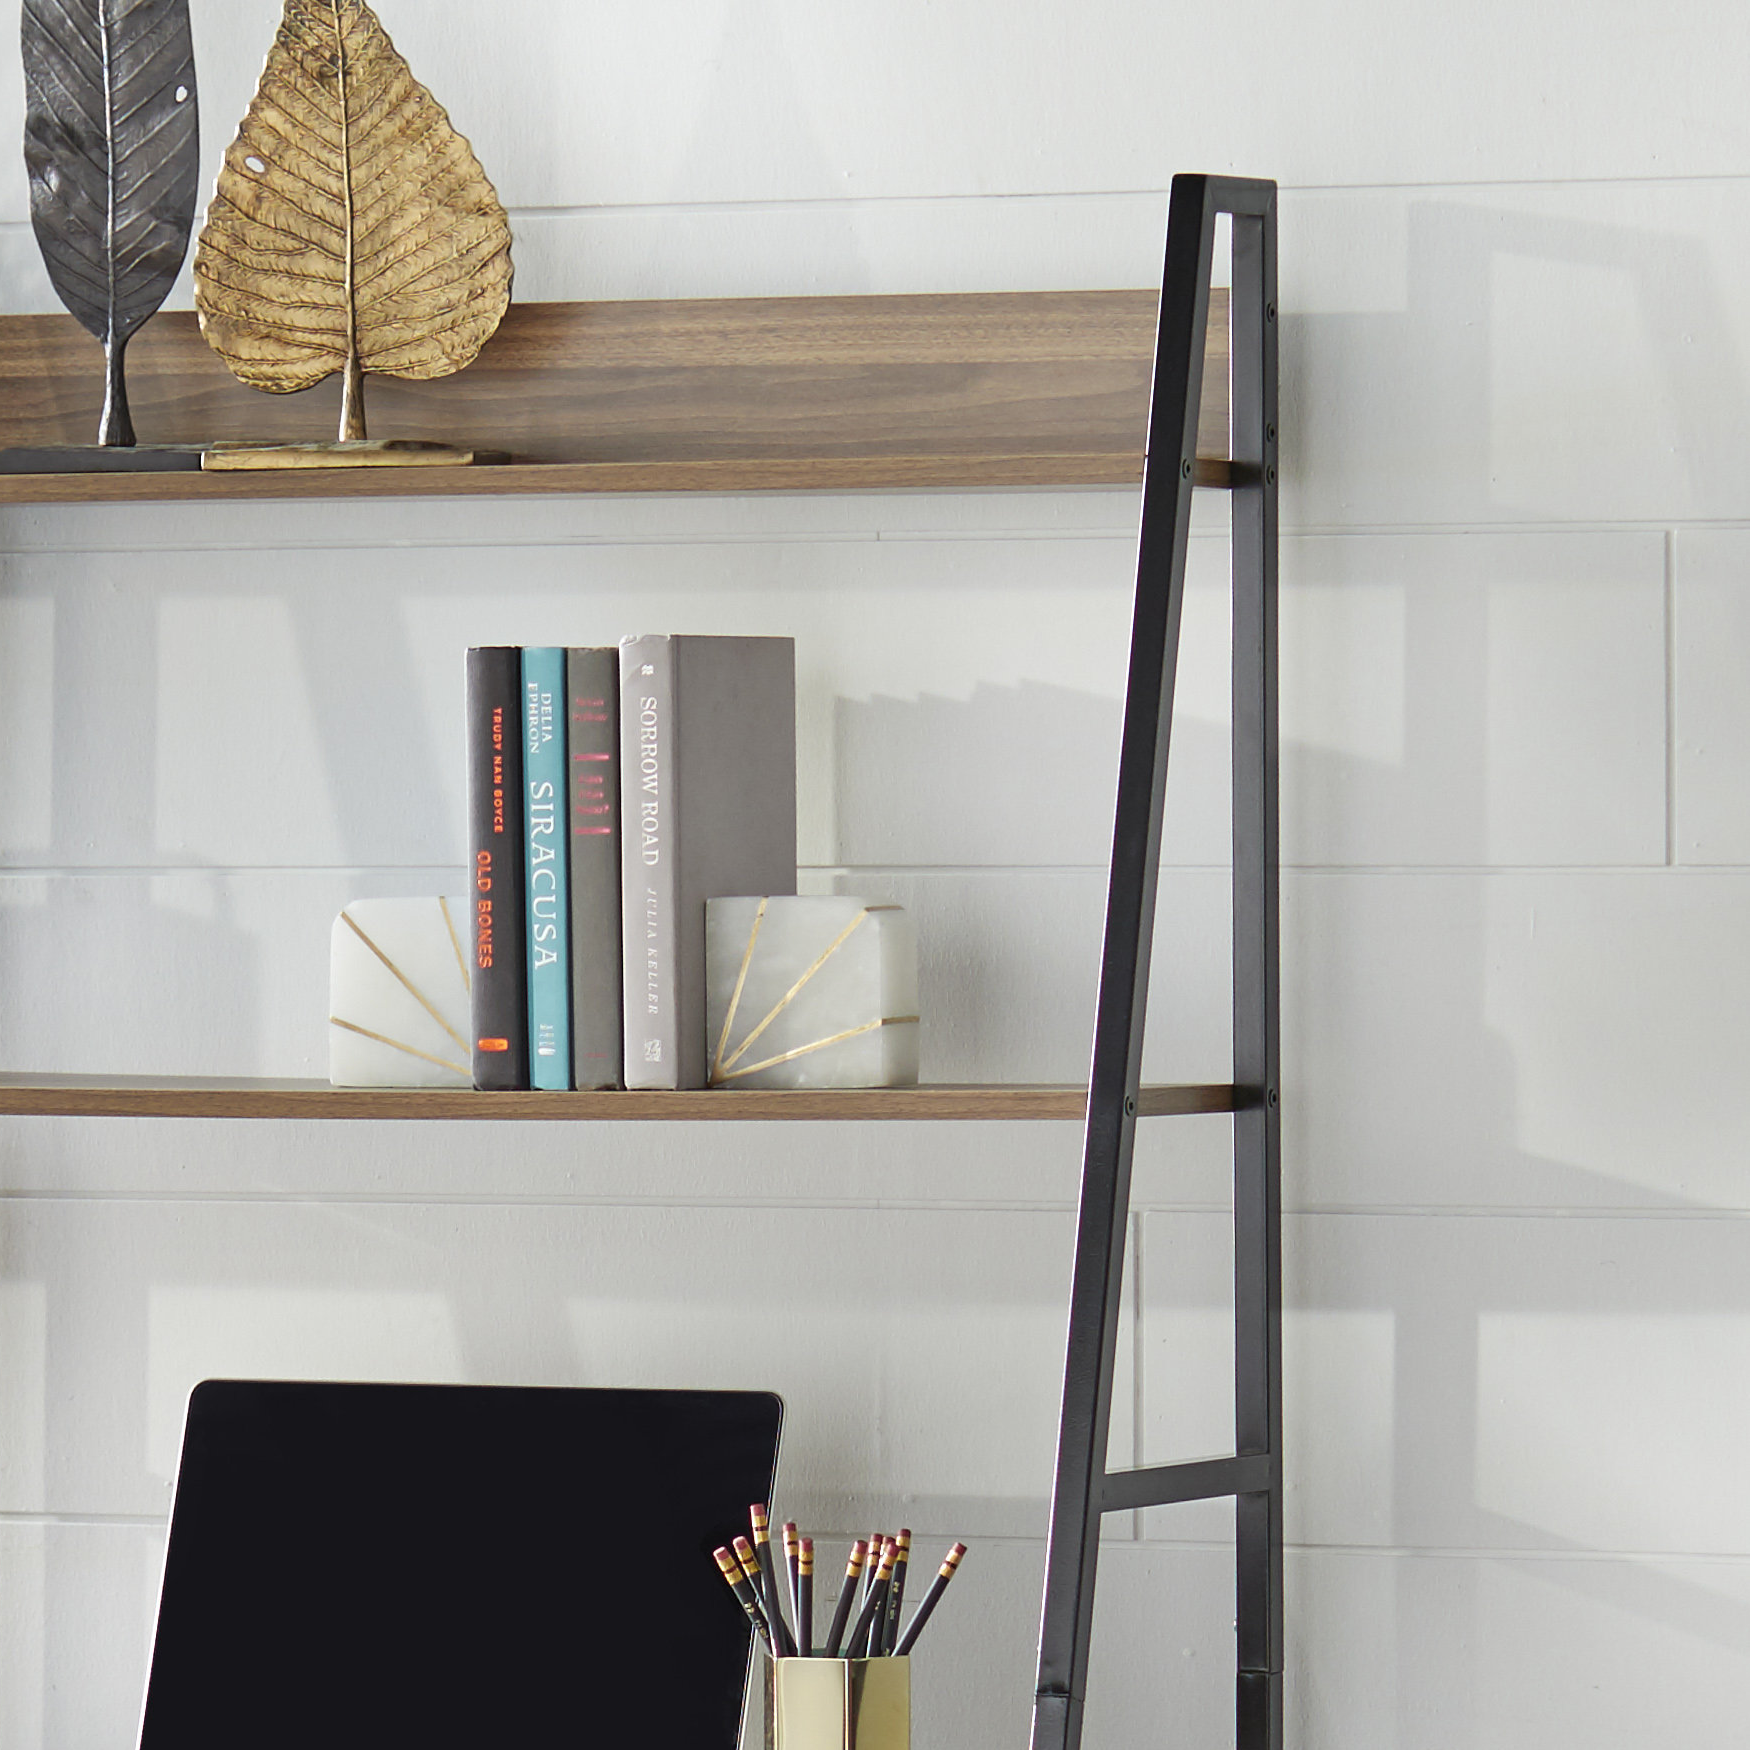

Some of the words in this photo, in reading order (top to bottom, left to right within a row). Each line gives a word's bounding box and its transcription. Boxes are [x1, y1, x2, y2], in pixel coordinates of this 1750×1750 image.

[493, 707, 503, 750] TRUDY
[528, 683, 539, 754] EPHRON
[541, 693, 553, 742] DELIA
[640, 696, 658, 795] SORROW
[493, 789, 504, 833] BOYCE
[641, 801, 659, 866] ROAD
[477, 851, 492, 892] OLD
[530, 781, 557, 970] SIRACUSA
[478, 900, 493, 969] BONES
[647, 888, 657, 938] JULIA
[647, 948, 659, 1014] KELLER
